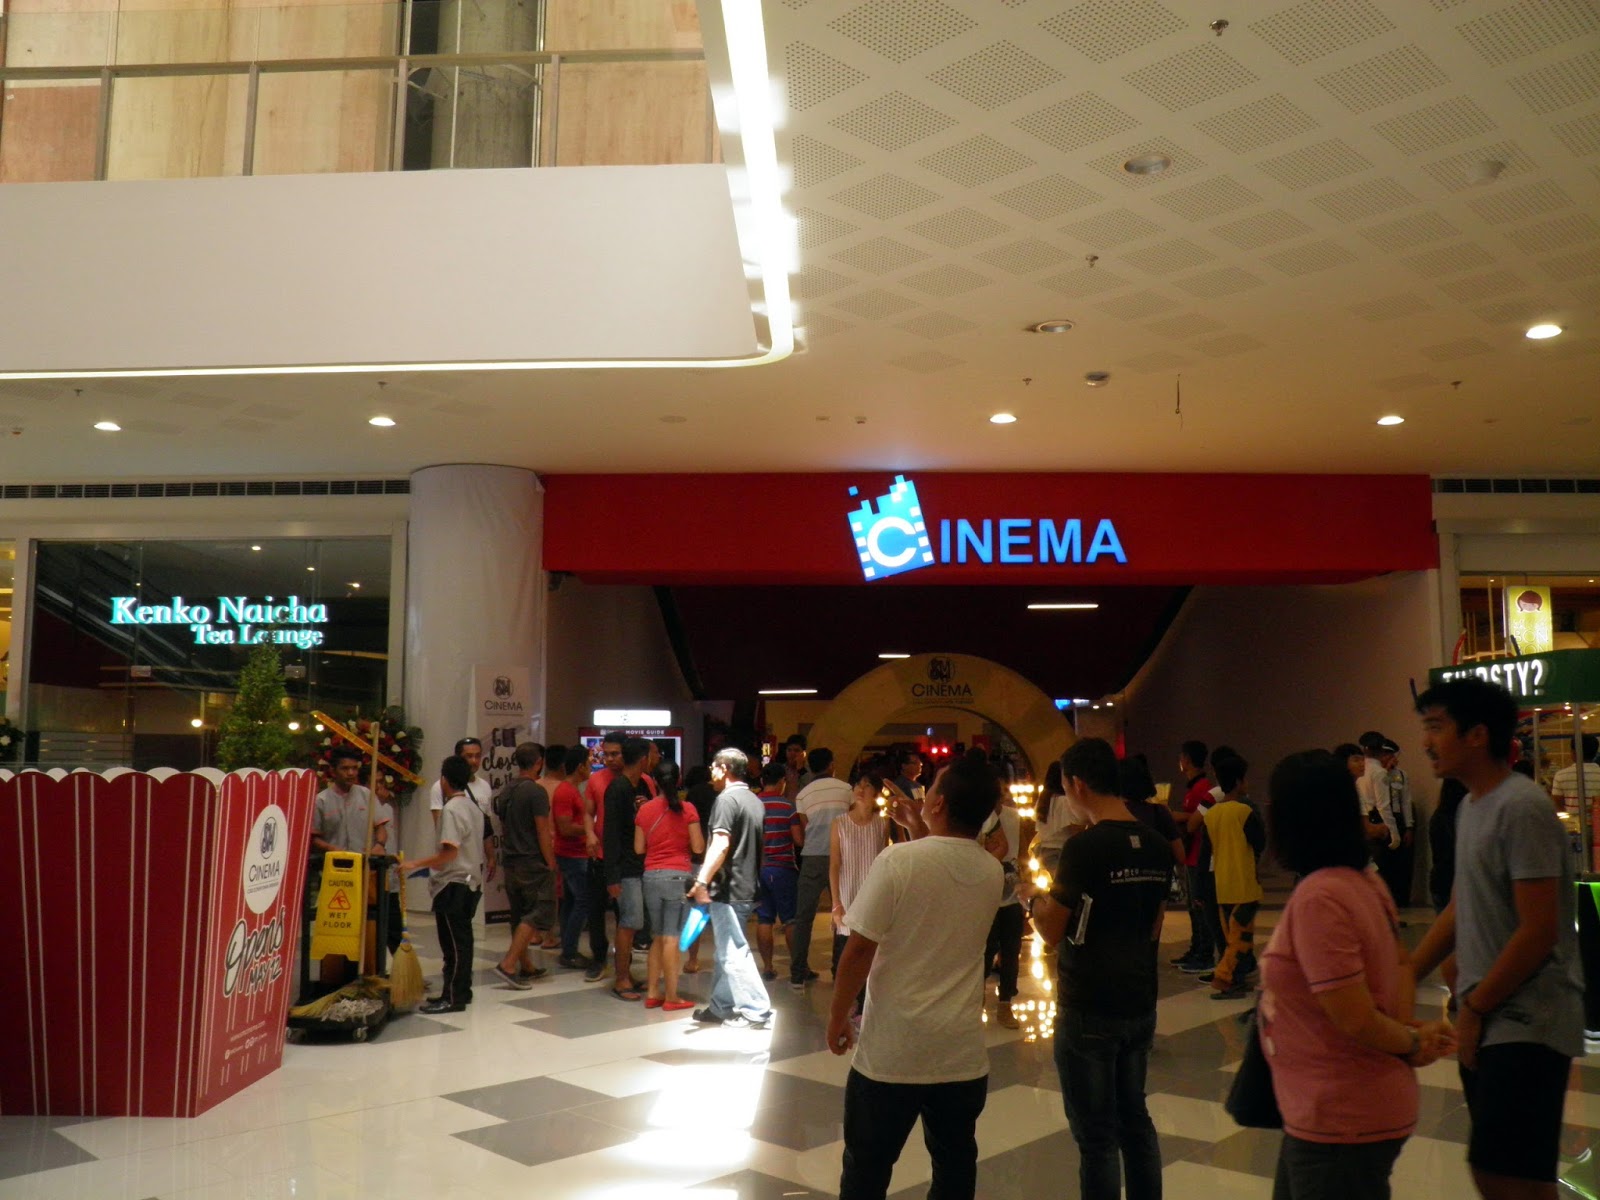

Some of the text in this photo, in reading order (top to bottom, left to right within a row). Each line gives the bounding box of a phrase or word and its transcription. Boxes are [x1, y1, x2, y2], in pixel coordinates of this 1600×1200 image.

[866, 516, 1128, 568] CINEMA
[110, 594, 328, 624] Kenko Naicha
[191, 624, 234, 645] Tea
[1442, 658, 1544, 697] RSTY?
[912, 682, 973, 697] CINEMA
[484, 700, 524, 712] CINEMA
[248, 860, 280, 883] CINEMA
[328, 879, 354, 888] CAUTION
[323, 920, 352, 929] FLOOR
[223, 906, 286, 997] Opens
[246, 955, 283, 994] MAY 12
